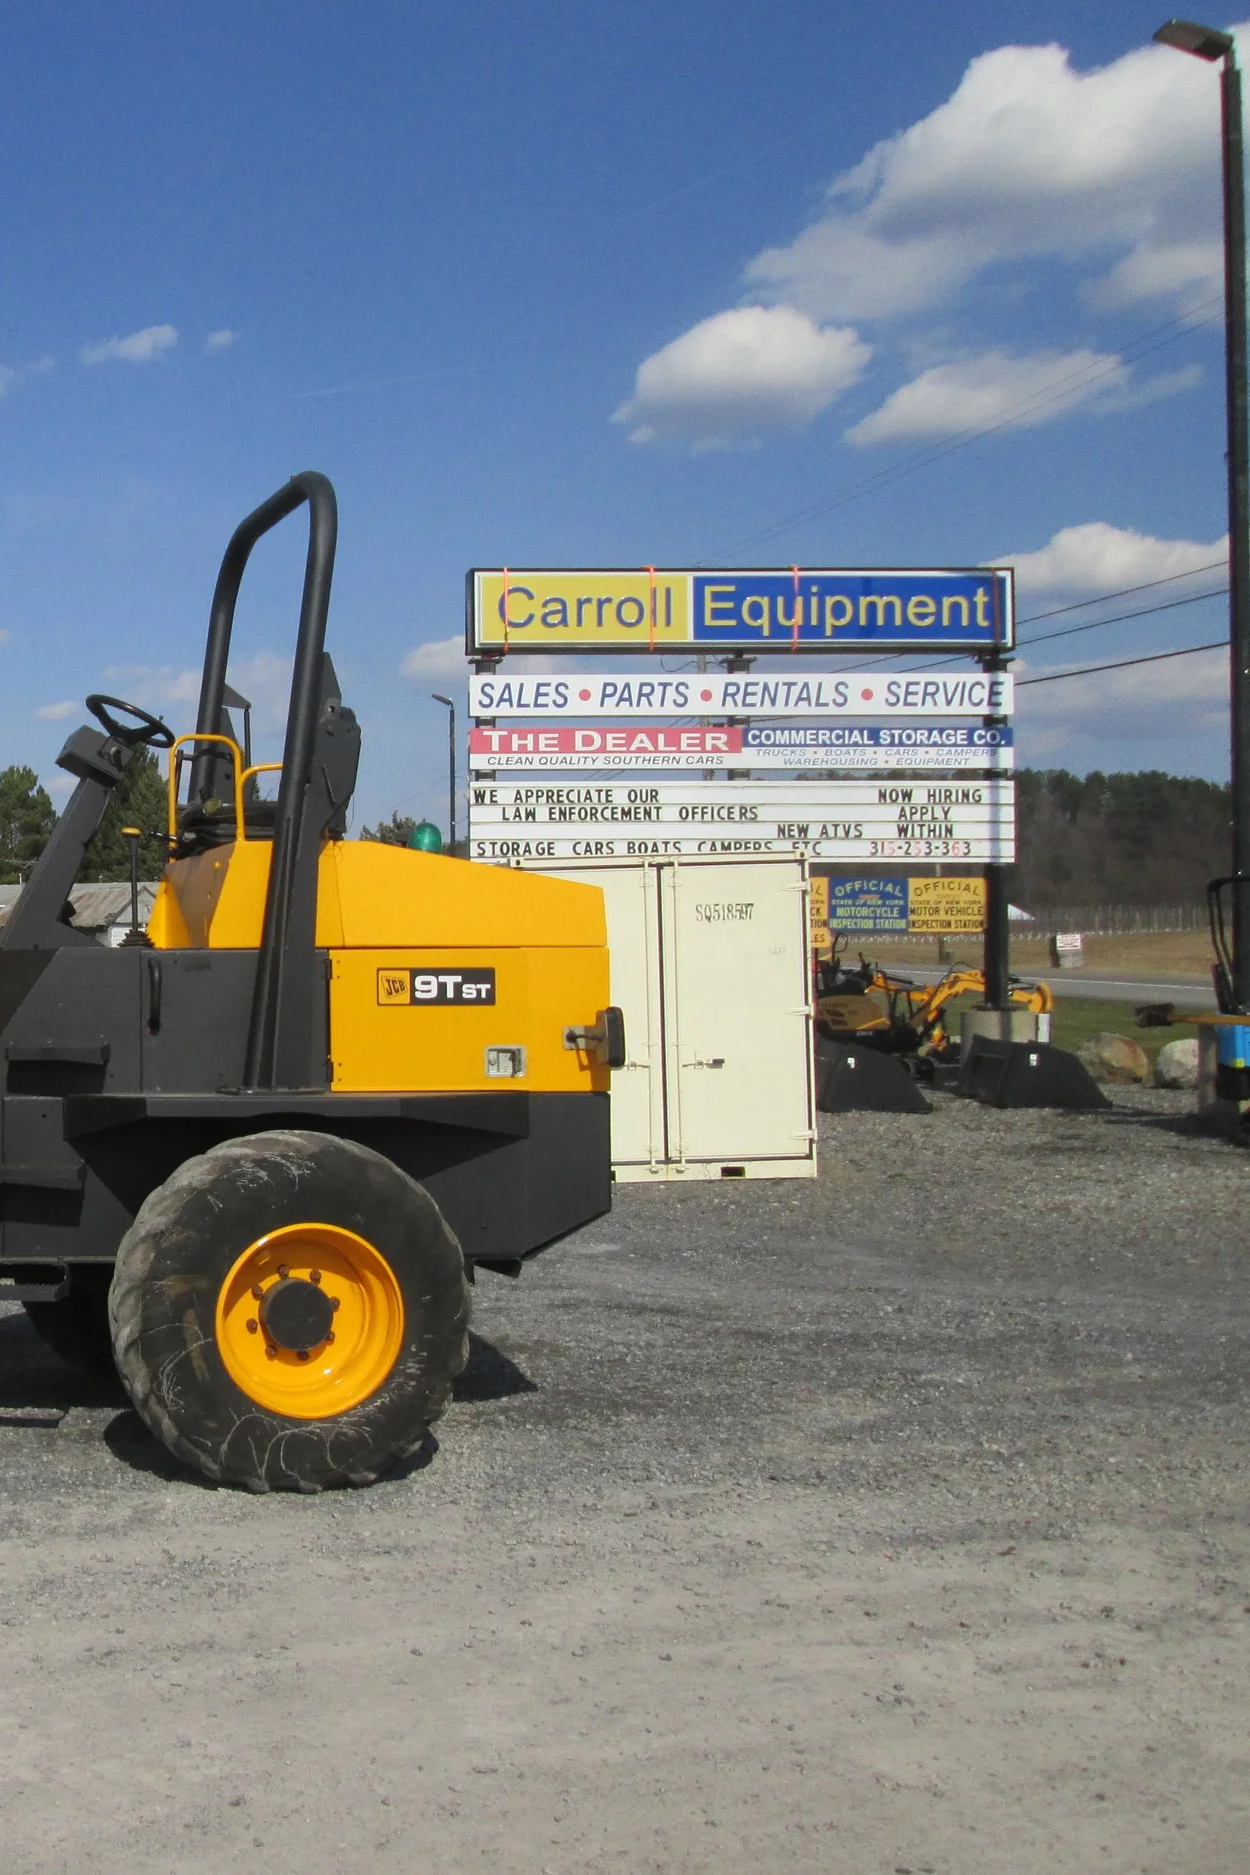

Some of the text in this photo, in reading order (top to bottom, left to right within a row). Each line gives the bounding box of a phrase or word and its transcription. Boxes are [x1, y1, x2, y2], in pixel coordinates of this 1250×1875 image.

[497, 585, 991, 637] Carroll Equipment
[478, 680, 1006, 709] SALES PARTS RENTALS SERVICE
[482, 729, 730, 752] THE DEALER
[747, 729, 1006, 746] COMMERCIAL STORAGE CO.
[755, 748, 998, 757] TRUCKS BOATS CARS CAMPERS
[487, 755, 725, 767] CLEAN QUALITY SOUTHERN CARS
[783, 757, 971, 766] WAREHOUSING EQUIPMENT
[473, 788, 660, 805] WE APPRECIATE OUR
[877, 788, 983, 804] NOW HIRING
[501, 805, 759, 822] LAW ENFORCEMENT OFFICERS
[898, 806, 951, 821] APPLY
[777, 823, 864, 838] NEW ATVS
[896, 823, 954, 839] WITHIN
[477, 841, 556, 856] STORAGE
[572, 841, 615, 856] CARS
[627, 840, 682, 854] BOATS
[697, 840, 774, 852] CAMPERS
[870, 840, 973, 856] 315-253-363
[834, 880, 903, 897] OFFICIAL
[913, 880, 980, 897] OFFICIAL
[836, 906, 900, 917] MOTORCYCLE
[909, 906, 983, 917] MOTOR VEHICLE
[830, 918, 907, 929] INSPECTION STATION
[910, 919, 986, 929] INSPECTION STATION
[384, 977, 406, 997] JCB
